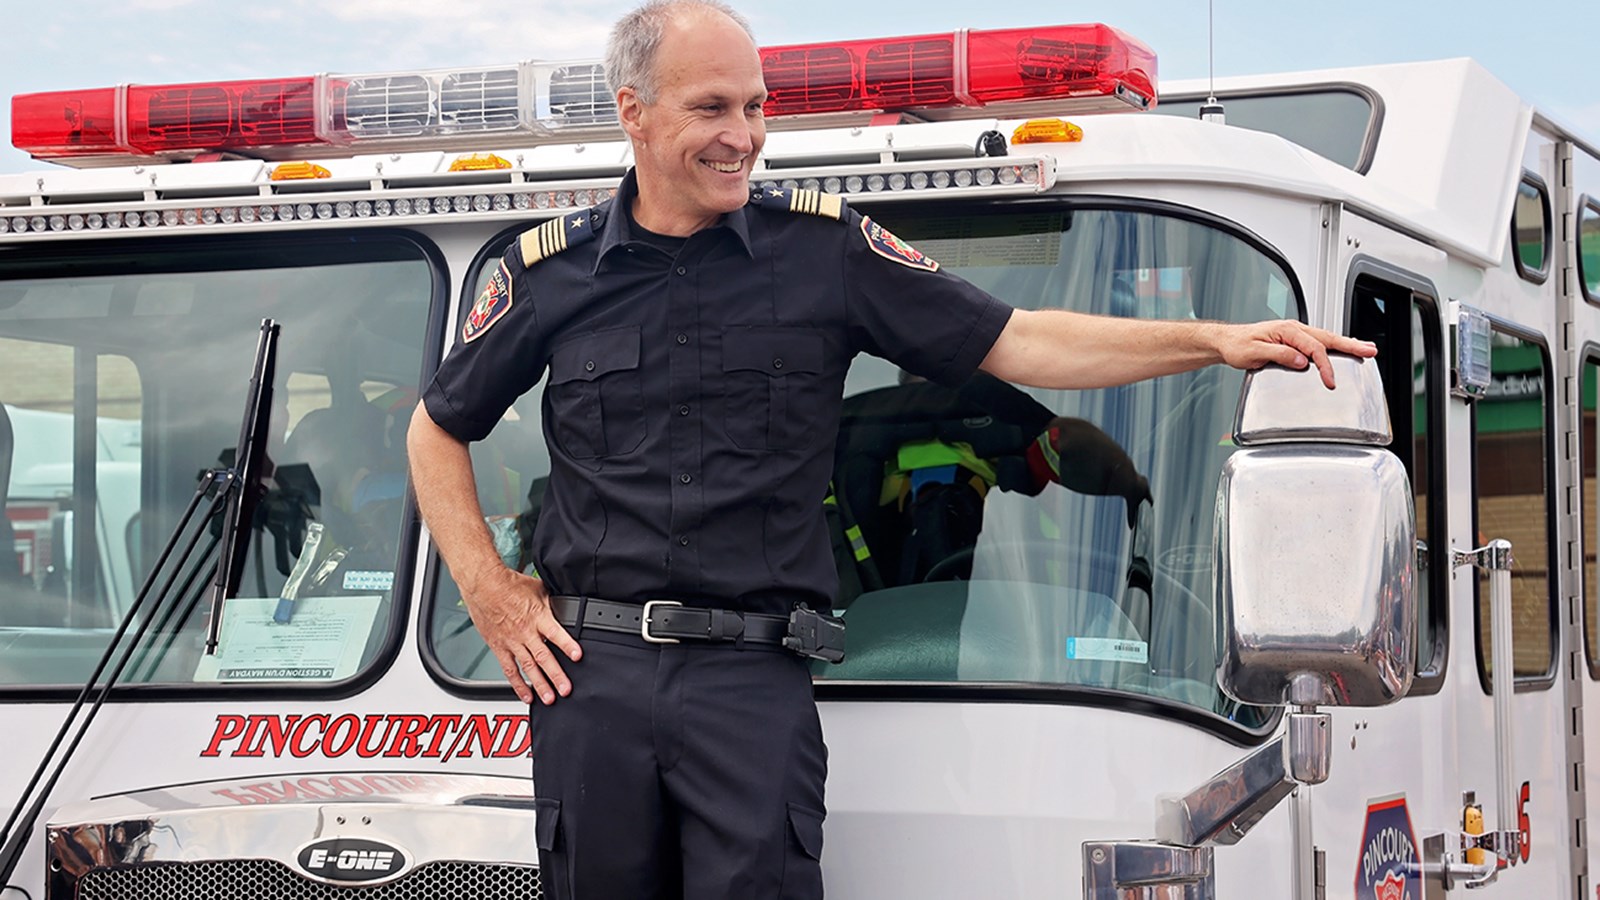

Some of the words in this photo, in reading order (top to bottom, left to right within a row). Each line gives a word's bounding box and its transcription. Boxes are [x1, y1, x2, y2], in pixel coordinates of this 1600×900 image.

[229, 669, 265, 678] MAYDAY
[264, 669, 286, 677] D'UN
[285, 669, 321, 677] GESTION
[322, 669, 333, 677] LA
[200, 714, 533, 762] PINCOURT/ND
[308, 849, 395, 871] E-ONE
[1362, 826, 1415, 887] PINCOURT
